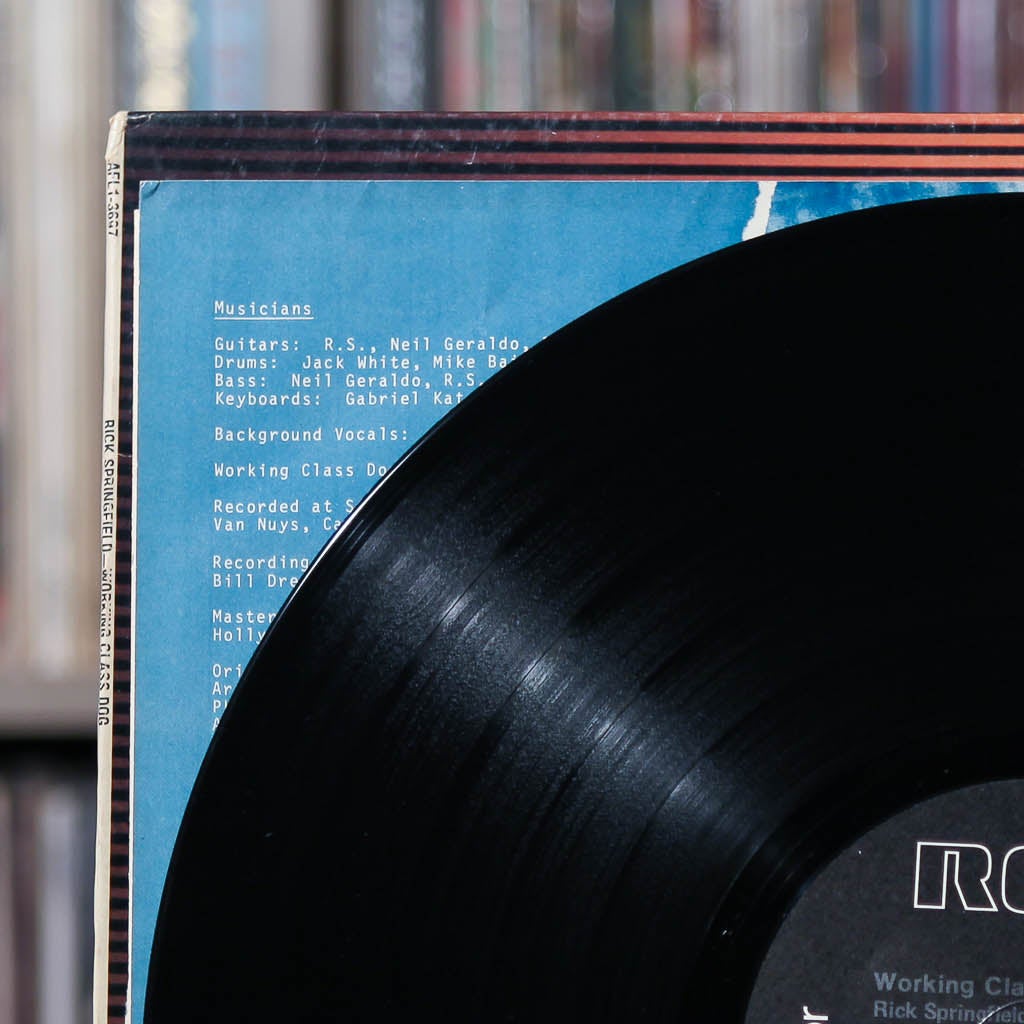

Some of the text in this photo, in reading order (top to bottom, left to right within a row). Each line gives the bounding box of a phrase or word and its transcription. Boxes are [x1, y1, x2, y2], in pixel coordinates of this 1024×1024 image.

[214, 301, 313, 316] Musicians
[214, 337, 299, 351] Guitars:
[324, 337, 377, 353] R.S.,
[390, 337, 431, 351] Neil
[444, 337, 529, 352] Geraldo,
[214, 355, 278, 369] Drums:
[302, 355, 345, 369] Jack
[357, 355, 420, 371] White,
[433, 355, 476, 369] Mike
[215, 373, 267, 387] Bass:
[291, 373, 332, 387] Neil
[346, 373, 431, 389] Geraldo,
[215, 391, 464, 408] Keyboards: Gabriel Kat
[103, 419, 115, 453] RICK
[214, 427, 408, 444] Background Vocals:
[214, 463, 290, 480] Working
[302, 463, 354, 477] Class
[214, 499, 299, 513] Recorded
[312, 499, 333, 513] at
[214, 517, 245, 531] Van
[258, 518, 309, 533] Nuys,
[212, 555, 310, 571] Recording
[213, 574, 299, 588] Bill Dre
[97, 697, 110, 726] DOG
[873, 971, 975, 998] Working
[873, 999, 918, 1019] Rick
